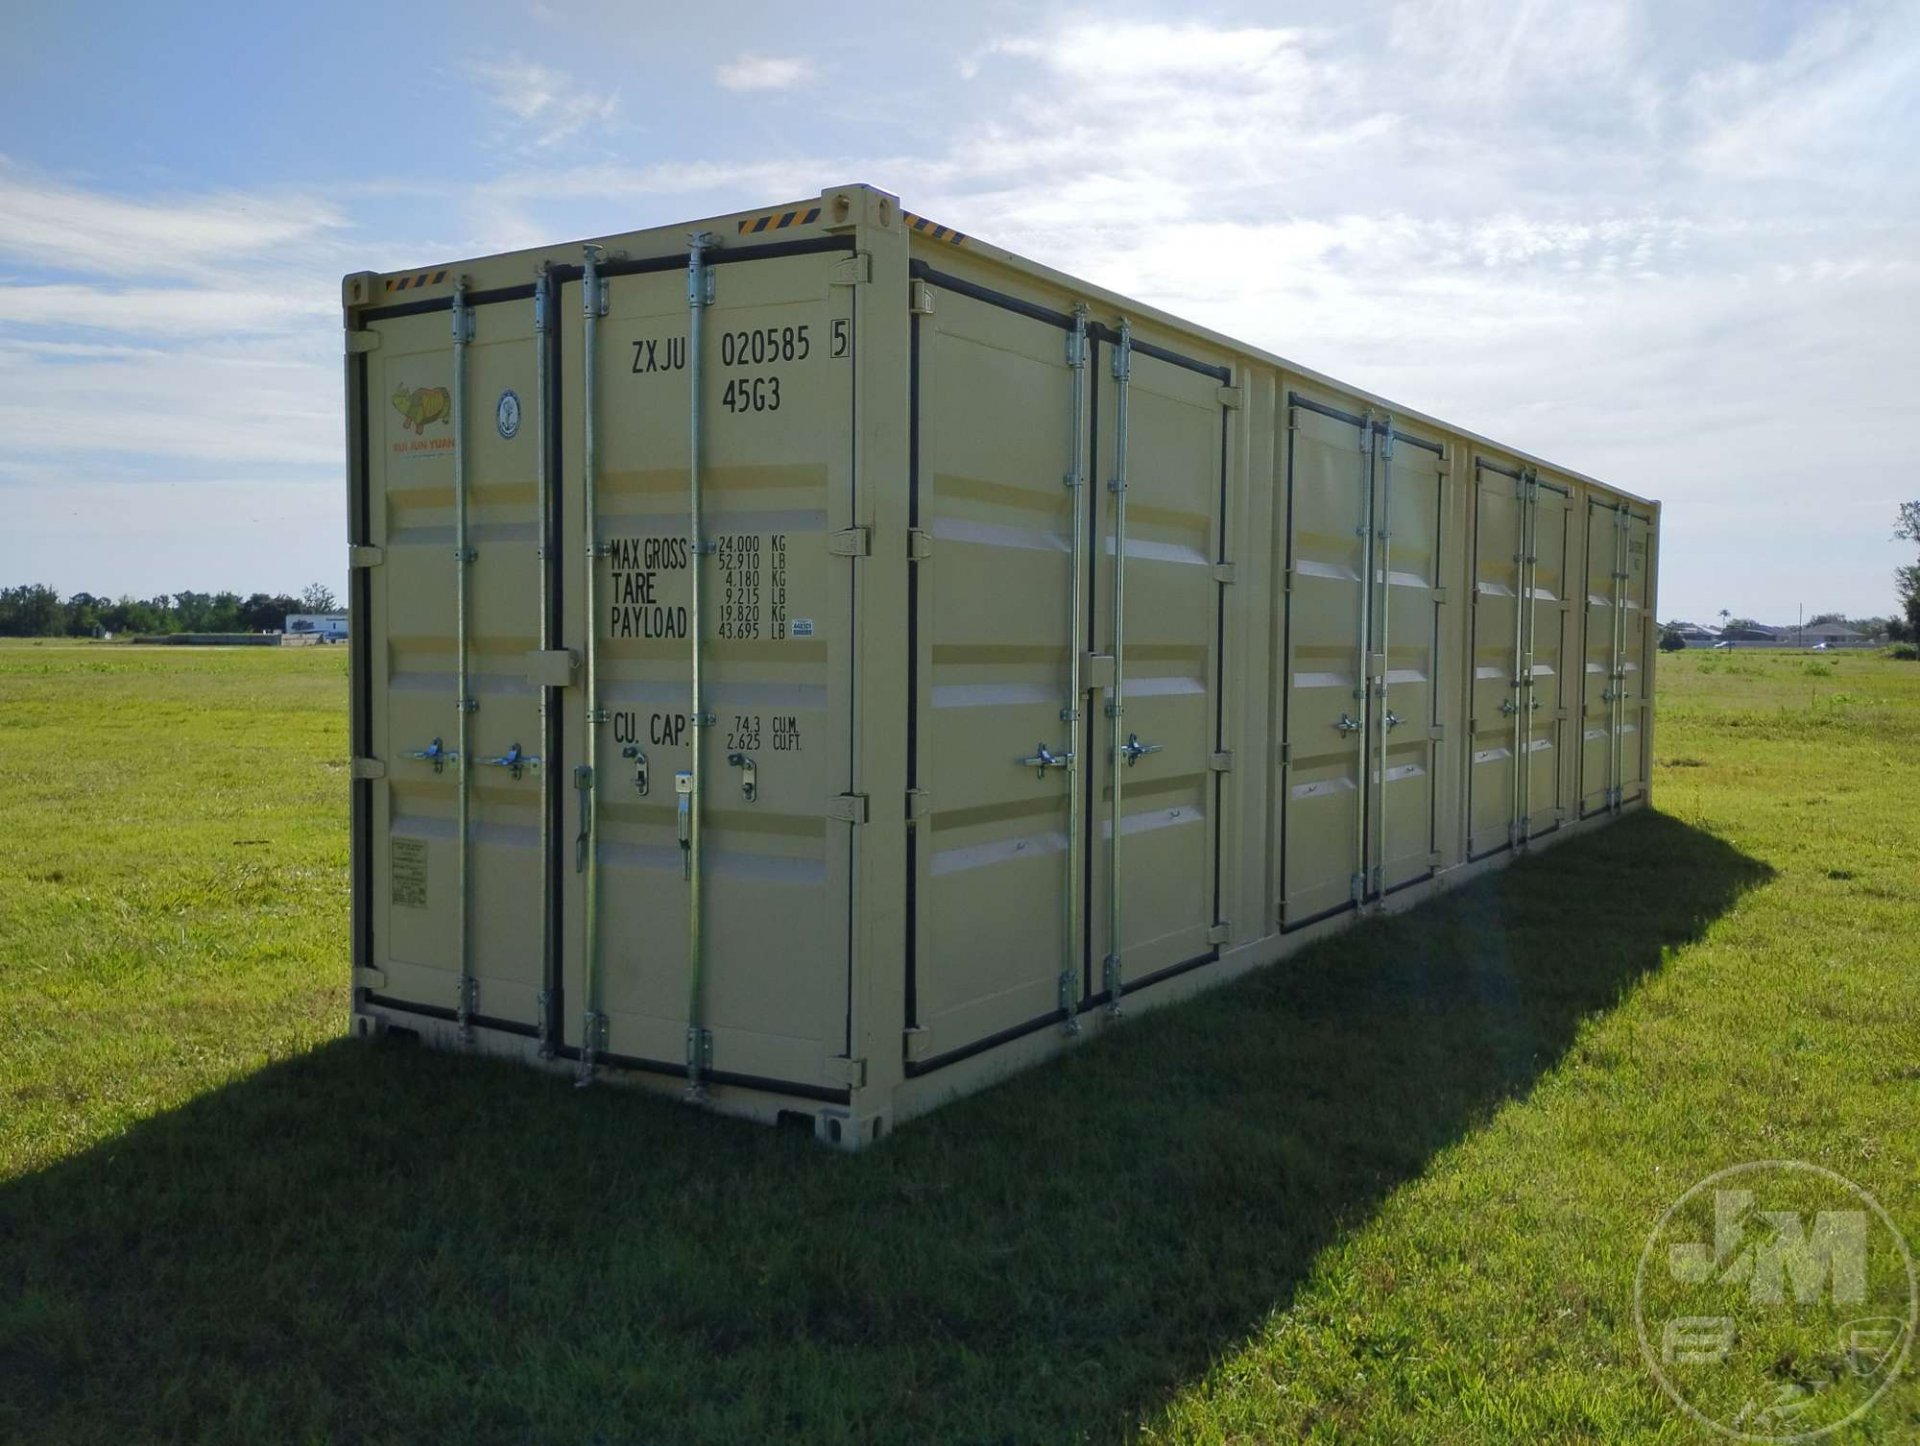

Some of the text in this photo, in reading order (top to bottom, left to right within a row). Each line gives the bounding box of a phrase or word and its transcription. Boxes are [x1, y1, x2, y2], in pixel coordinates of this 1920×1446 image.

[632, 321, 847, 373] ZXJU 020585 5
[722, 376, 780, 413] 45G3
[771, 535, 786, 552] KG
[611, 538, 687, 570] MAX GROSS
[771, 553, 786, 570] LB
[771, 571, 786, 587] KG
[612, 572, 657, 604] TARE
[771, 588, 786, 605] LB
[771, 605, 786, 622] KG
[611, 606, 687, 639] PAYLOAD
[771, 623, 786, 640] LB
[614, 712, 689, 747] CU. CAP.
[735, 716, 760, 733] 74.3
